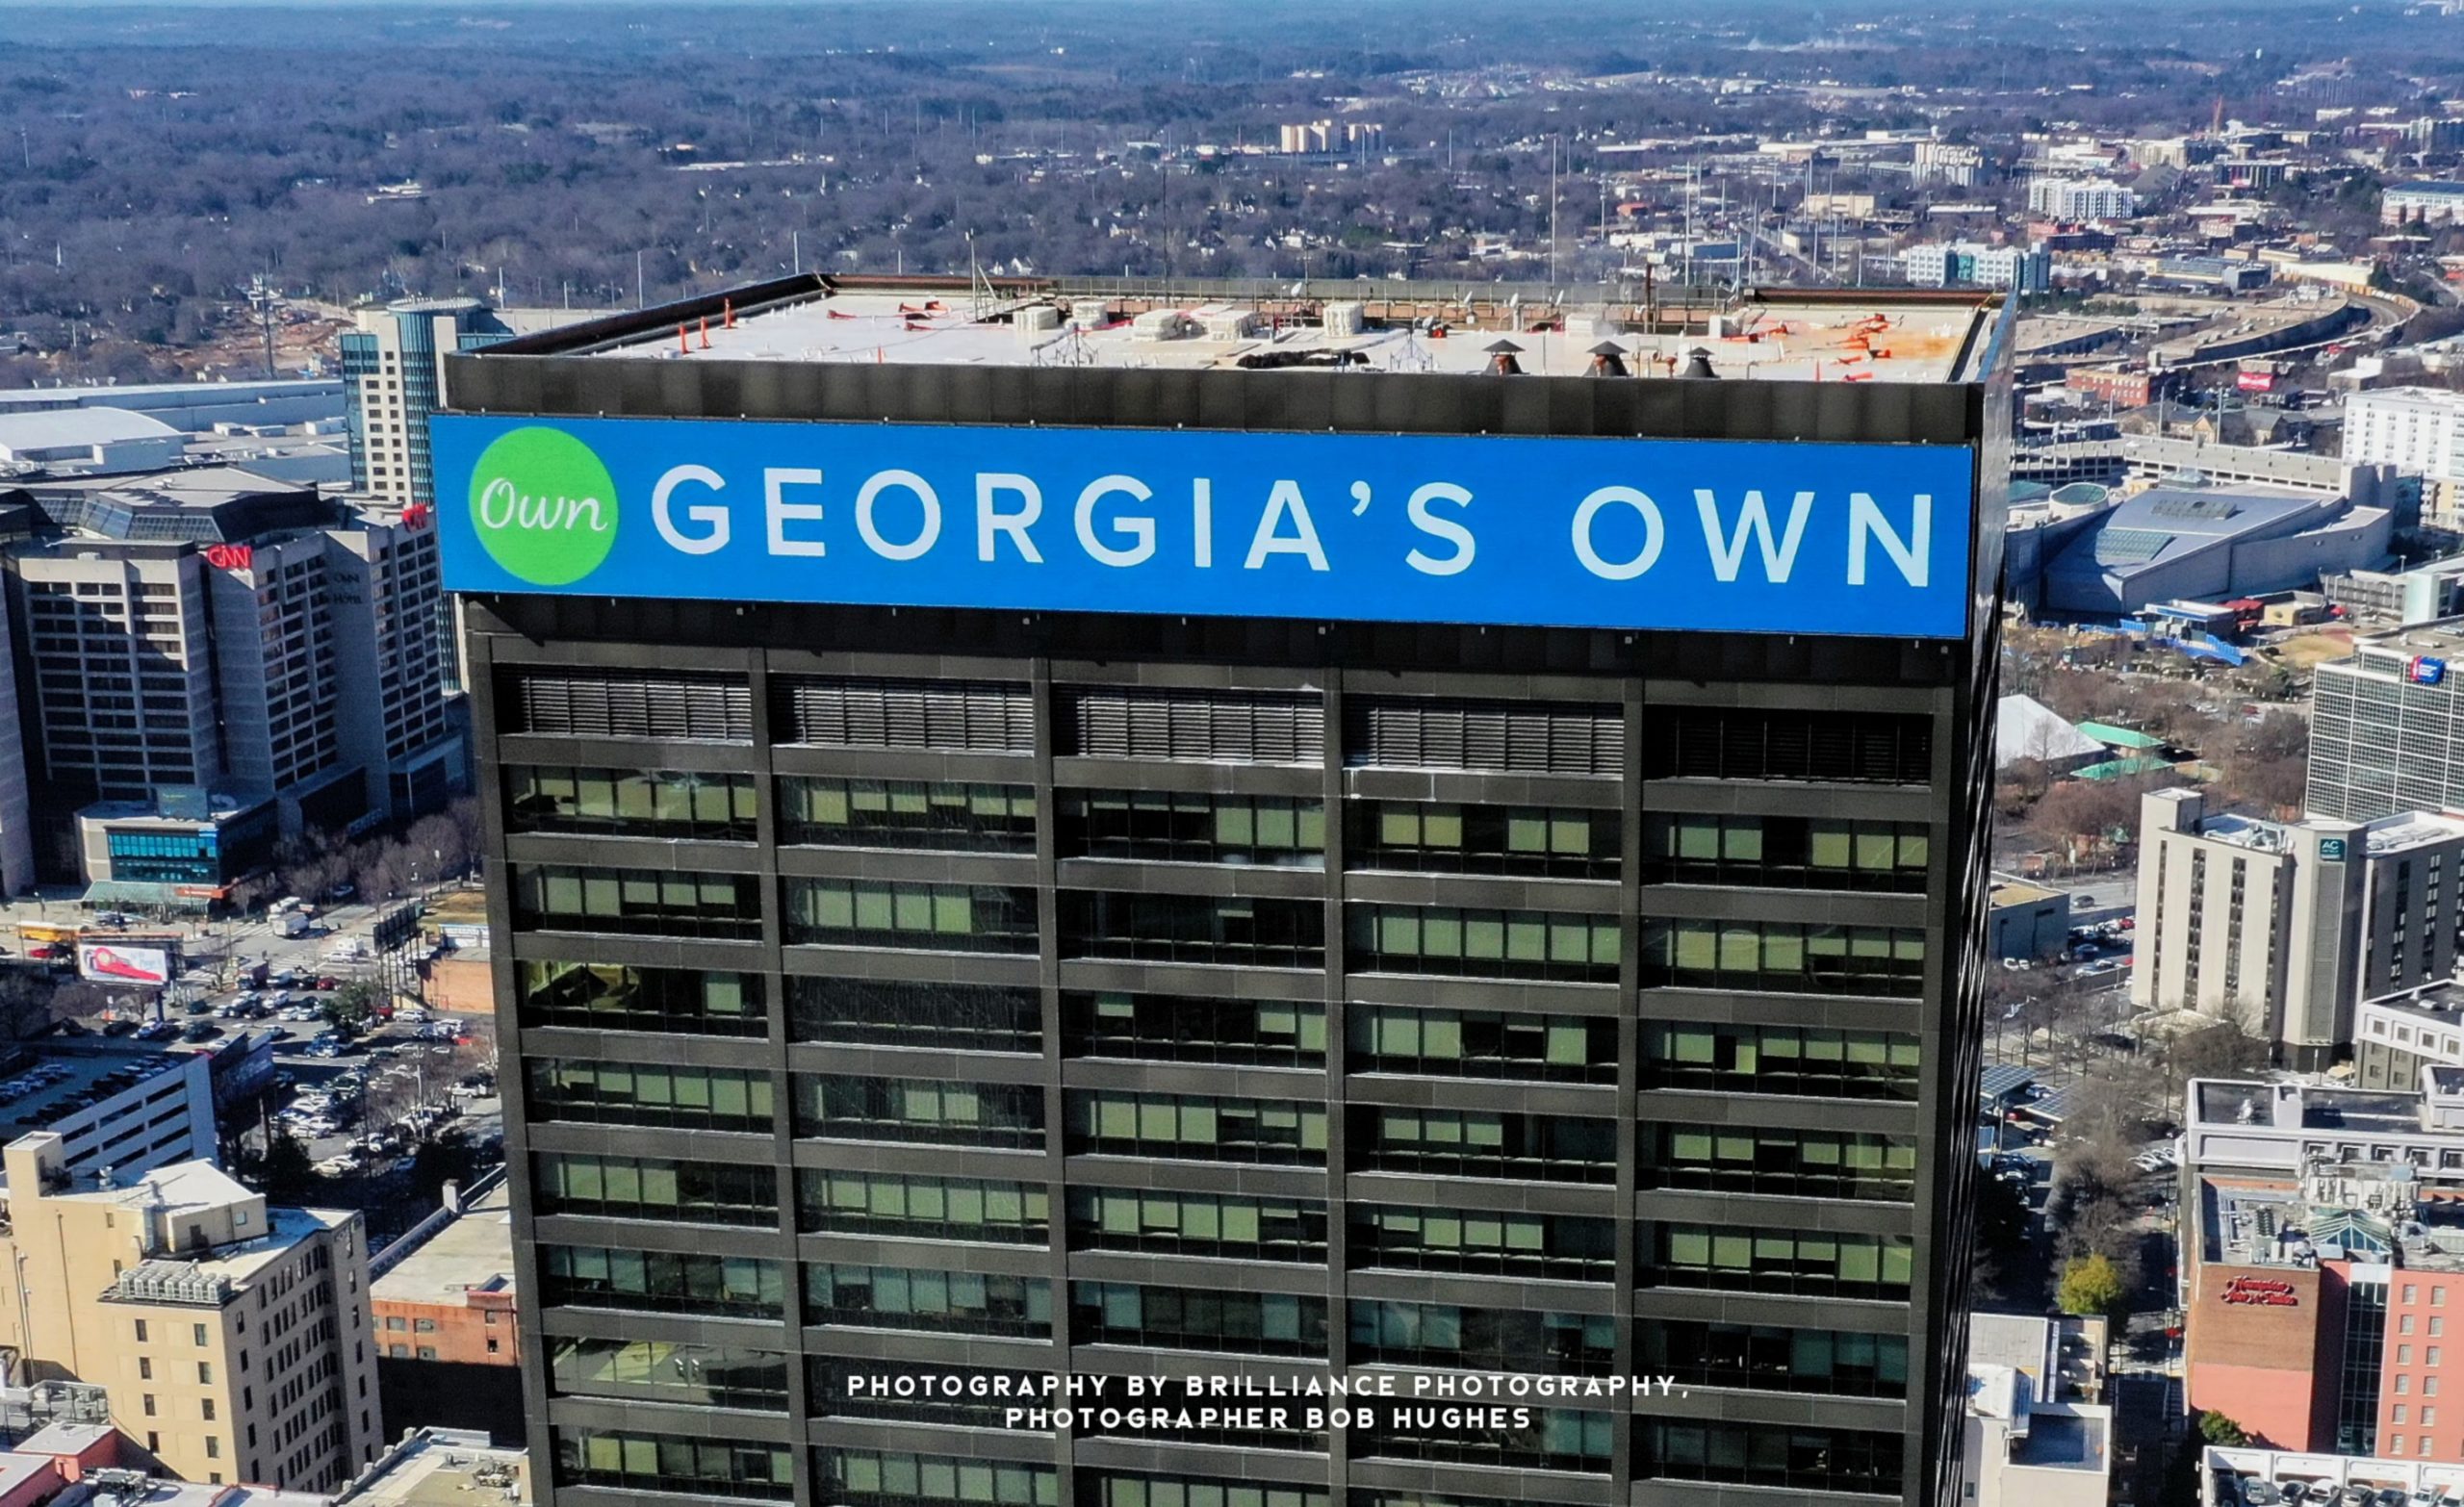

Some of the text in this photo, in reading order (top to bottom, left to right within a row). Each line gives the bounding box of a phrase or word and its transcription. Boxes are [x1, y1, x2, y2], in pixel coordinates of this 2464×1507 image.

[480, 477, 608, 531] Own
[652, 464, 1932, 587] GEORGIA'S OWN
[207, 544, 252, 569] CNN
[2322, 840, 2339, 850] AC
